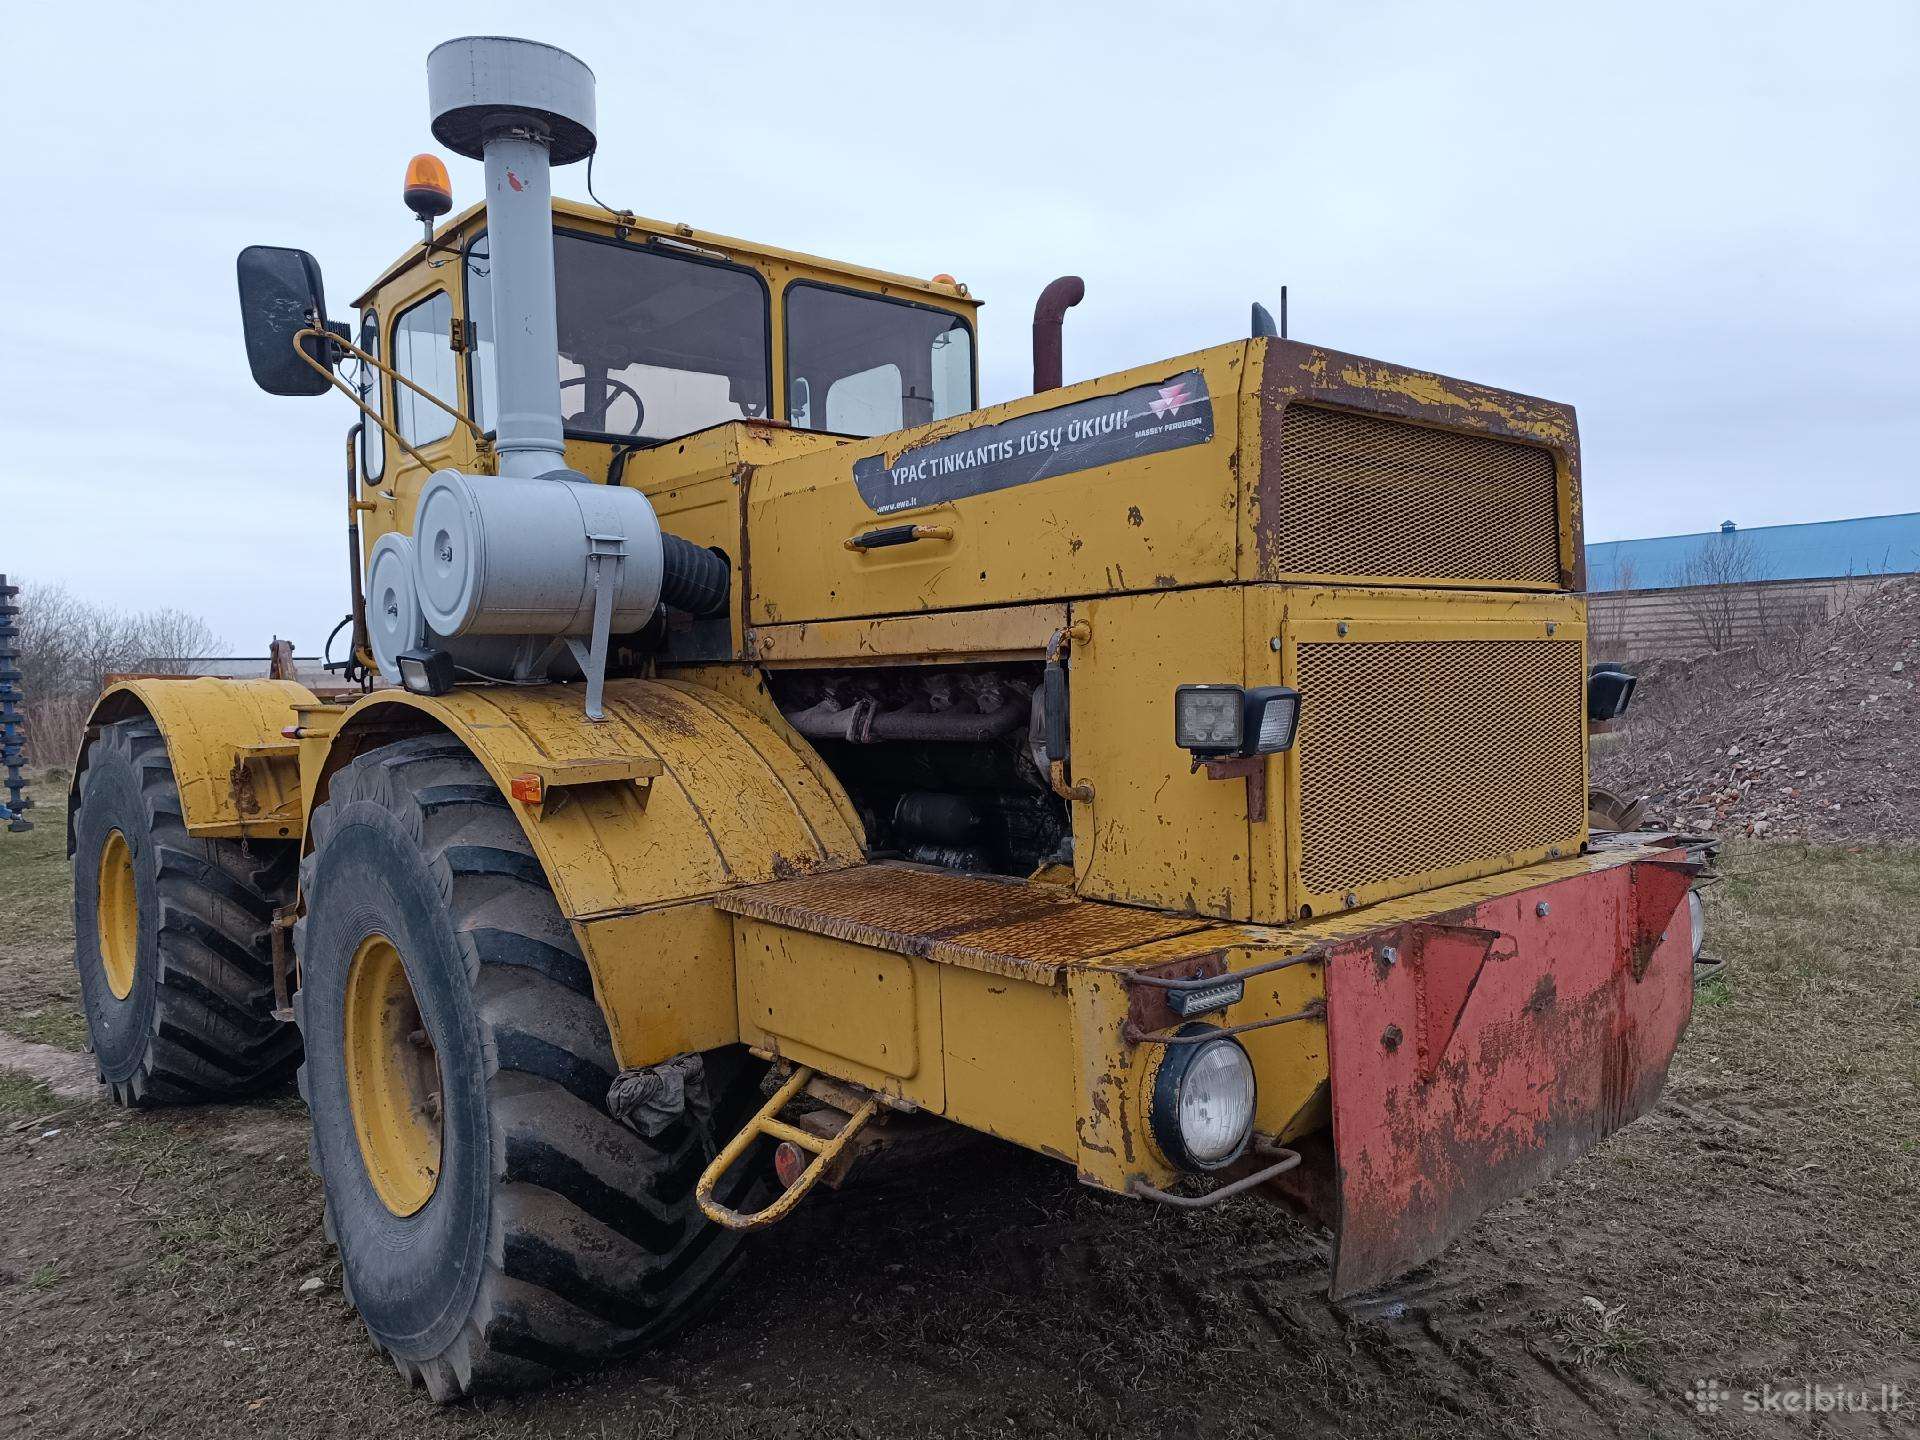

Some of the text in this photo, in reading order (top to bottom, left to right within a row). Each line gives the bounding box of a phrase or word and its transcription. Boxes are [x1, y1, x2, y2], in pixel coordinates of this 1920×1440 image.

[1134, 426, 1164, 439] MASSEY
[891, 459, 927, 486] YPAČ
[929, 440, 1013, 477] TINKANTIS
[1018, 427, 1062, 452] JŪSŲ
